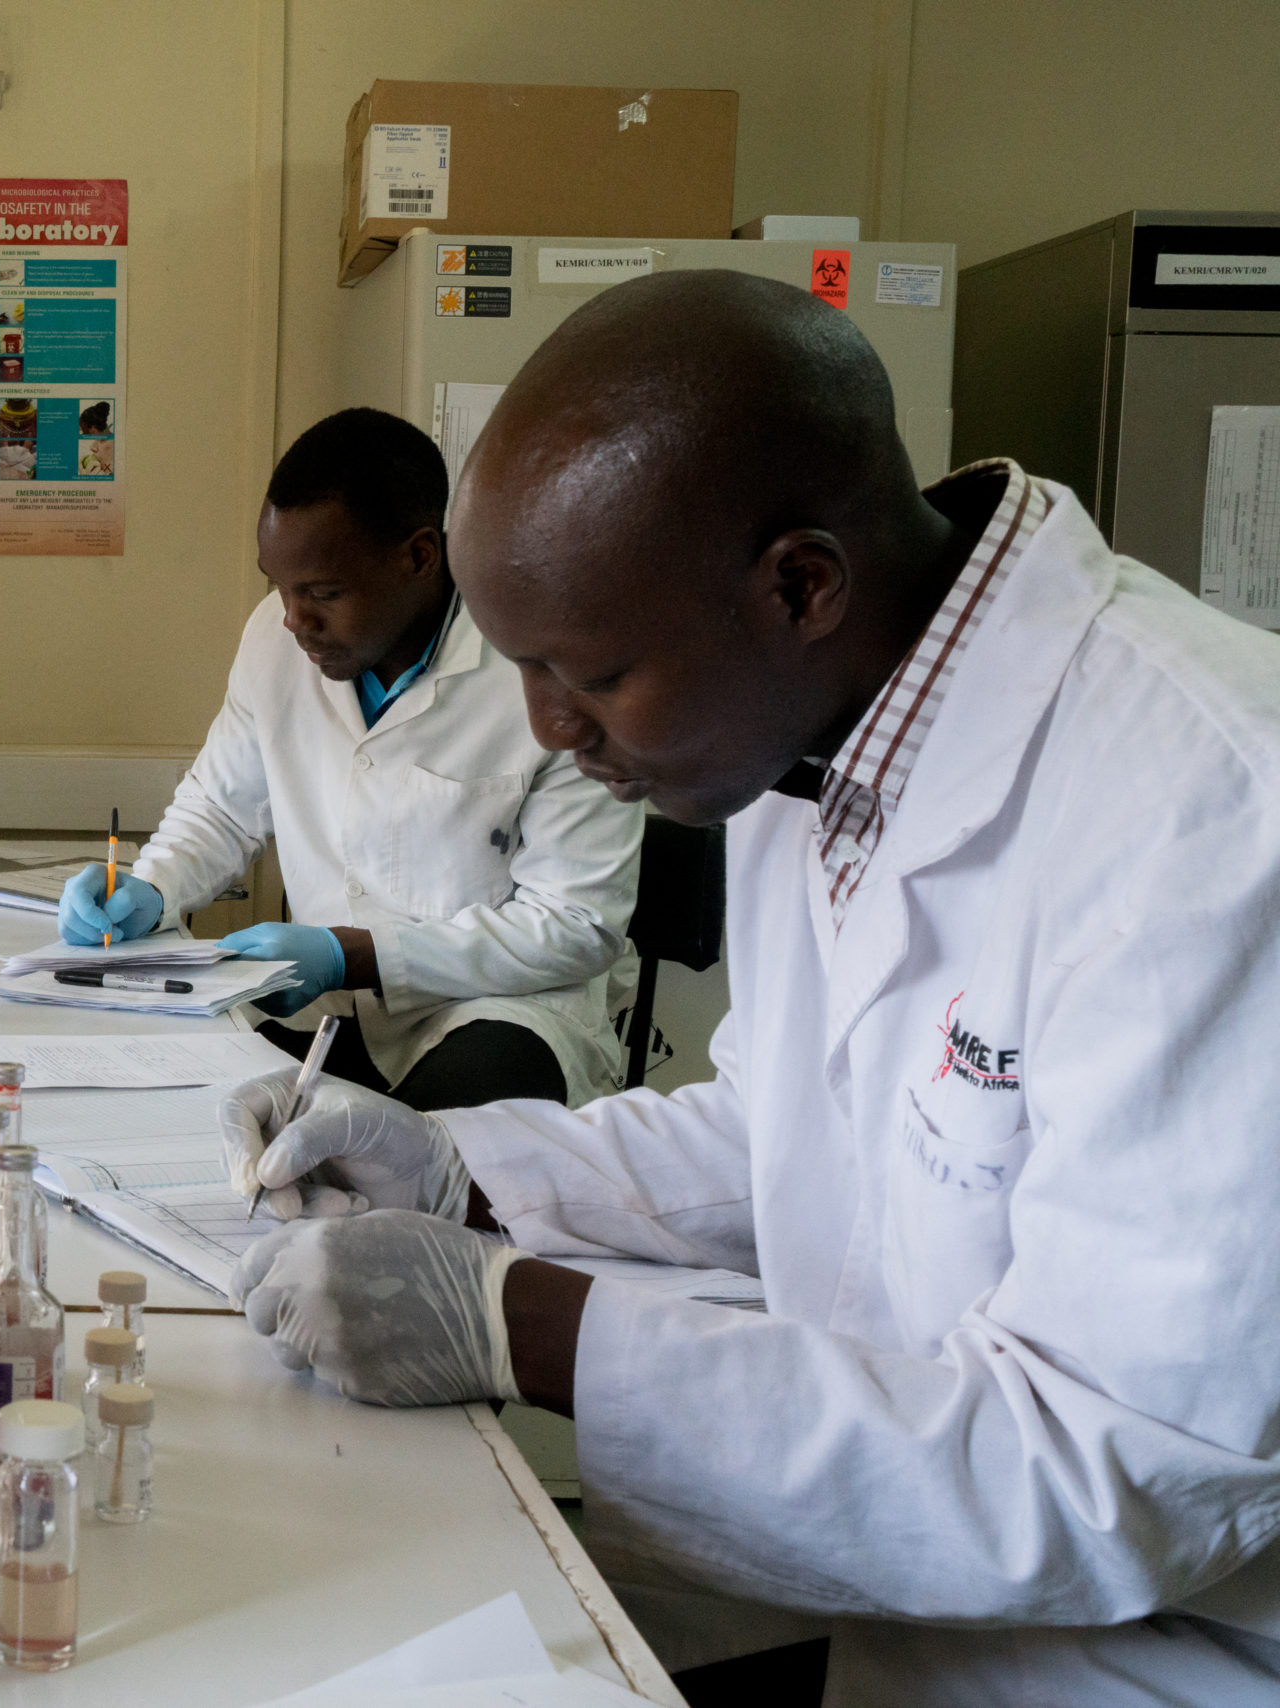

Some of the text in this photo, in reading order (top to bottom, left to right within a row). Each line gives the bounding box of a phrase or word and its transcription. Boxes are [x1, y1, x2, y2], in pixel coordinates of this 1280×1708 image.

[1, 188, 60, 197] MICROBIOLOGICAL
[62, 189, 100, 197] PRACTICES
[54, 202, 66, 215] IN
[69, 202, 91, 216] THE
[555, 258, 648, 268] KEMRI/CMR/WT/019
[1173, 266, 1267, 275] KEMRI/CMR/WT/020
[813, 289, 846, 298] BIOHAZARD
